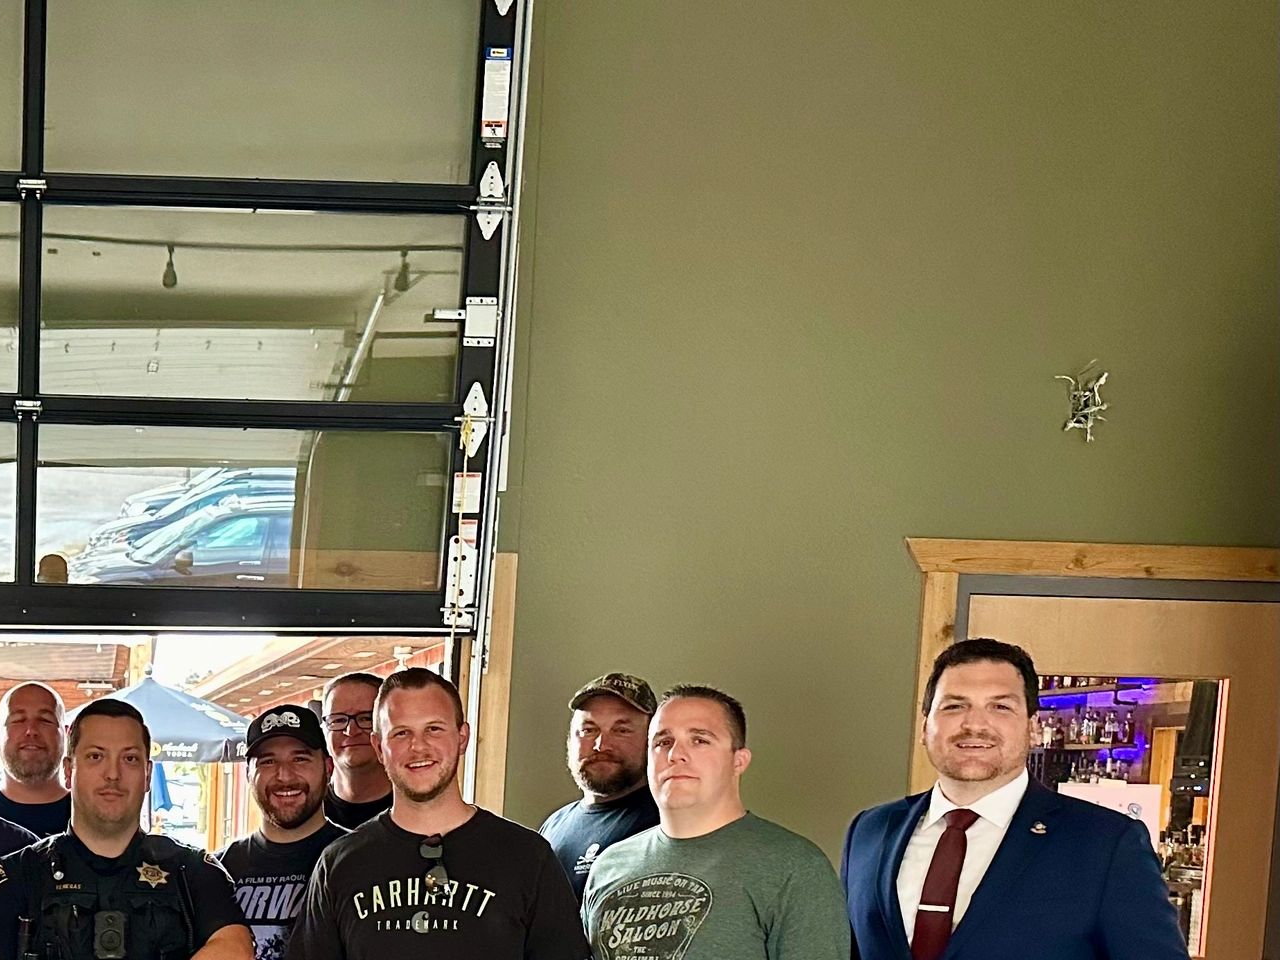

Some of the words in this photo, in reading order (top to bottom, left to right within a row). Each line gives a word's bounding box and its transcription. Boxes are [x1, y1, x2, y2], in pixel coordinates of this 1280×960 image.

[617, 881, 641, 896] LIVE
[642, 876, 673, 888] MUSIC
[673, 878, 687, 888] ON
[377, 919, 458, 931] TRADEMARK
[600, 897, 706, 933] WILDHORSE
[608, 919, 682, 949] SALOON
